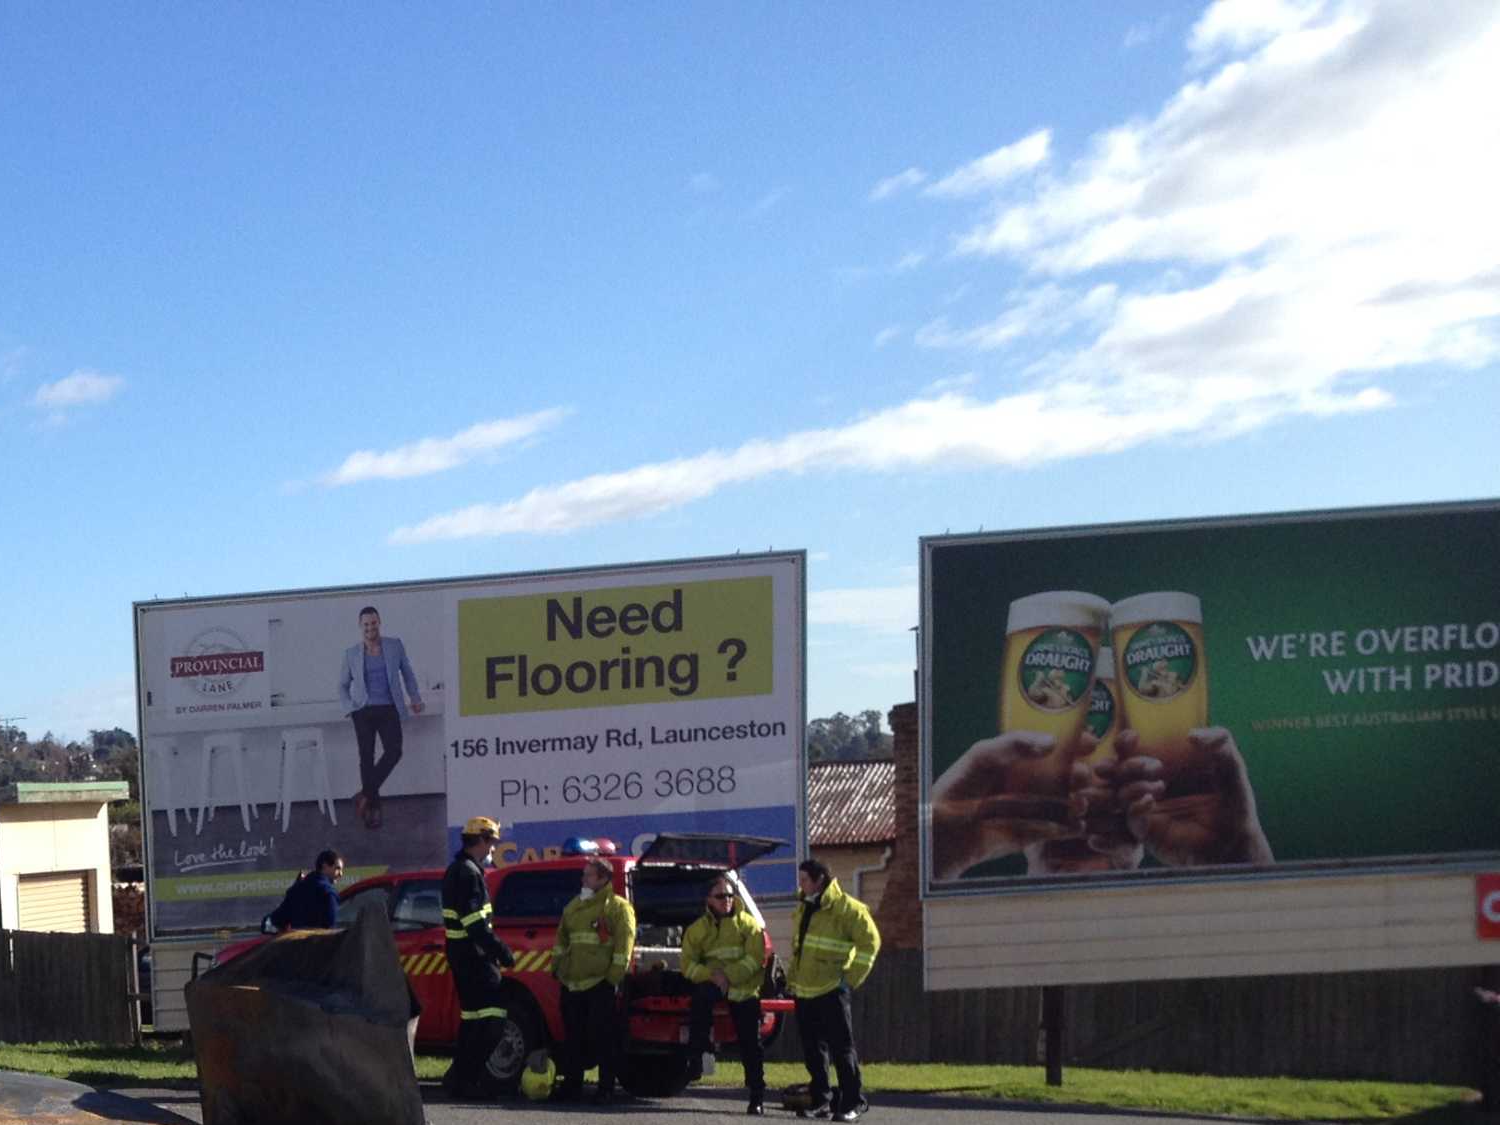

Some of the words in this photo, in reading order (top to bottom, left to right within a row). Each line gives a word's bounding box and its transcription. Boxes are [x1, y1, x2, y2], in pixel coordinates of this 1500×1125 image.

[547, 589, 683, 641] Need
[1126, 643, 1192, 665] DRAUGHT
[1246, 630, 1347, 661] WE'RE
[1356, 622, 1500, 656] OVERFLO
[174, 656, 260, 673] PROVINCIAL
[486, 646, 699, 699] Flooring
[717, 638, 748, 682] ?
[1025, 651, 1092, 673] DRAUGHT
[202, 681, 234, 693] LANE
[1322, 665, 1412, 695] WITH
[175, 706, 187, 714] BY
[189, 703, 225, 713] DARREN
[226, 701, 262, 711] PALMER
[1252, 718, 1312, 732] WINNER
[1315, 714, 1349, 729] BEST
[1352, 710, 1443, 726] AUSTRALIAN
[1446, 706, 1487, 721] STYLE
[450, 738, 488, 758] 156
[495, 733, 599, 756] Invermay
[606, 728, 643, 749] Rd,
[651, 719, 786, 745] Launceston
[500, 778, 549, 807] Ph:
[562, 771, 643, 804] 6326
[655, 765, 737, 798] 3688
[174, 849, 205, 867] Love
[211, 843, 235, 861] the
